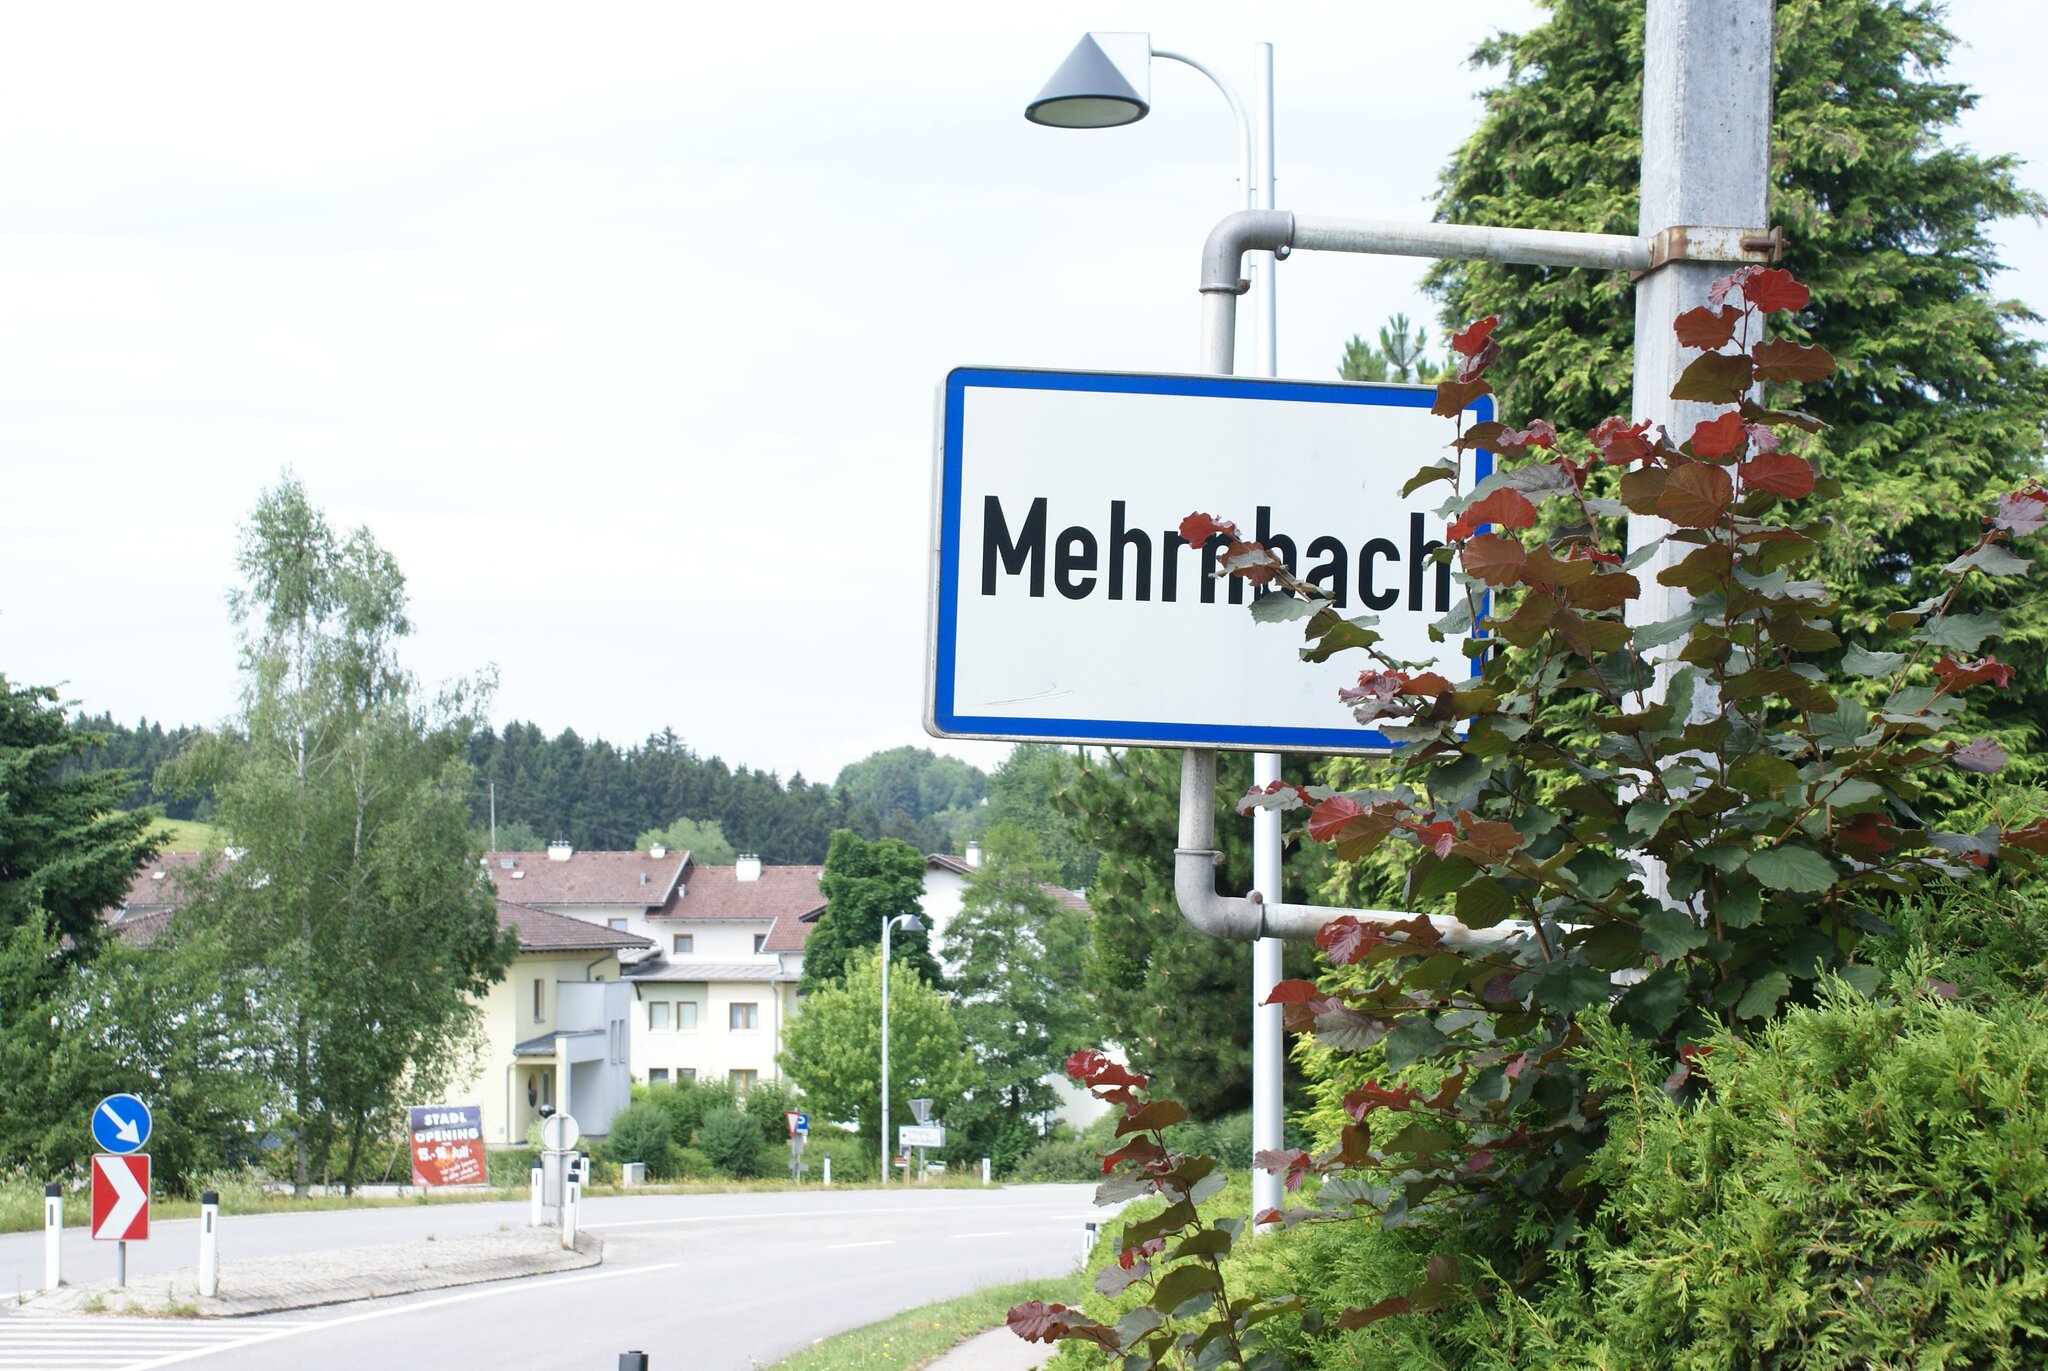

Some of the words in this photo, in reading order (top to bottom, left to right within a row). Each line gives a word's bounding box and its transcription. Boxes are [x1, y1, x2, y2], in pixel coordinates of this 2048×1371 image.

[981, 495, 1450, 612] Mehrnbach
[424, 1112, 467, 1126] STADL
[415, 1128, 479, 1143] OPENING
